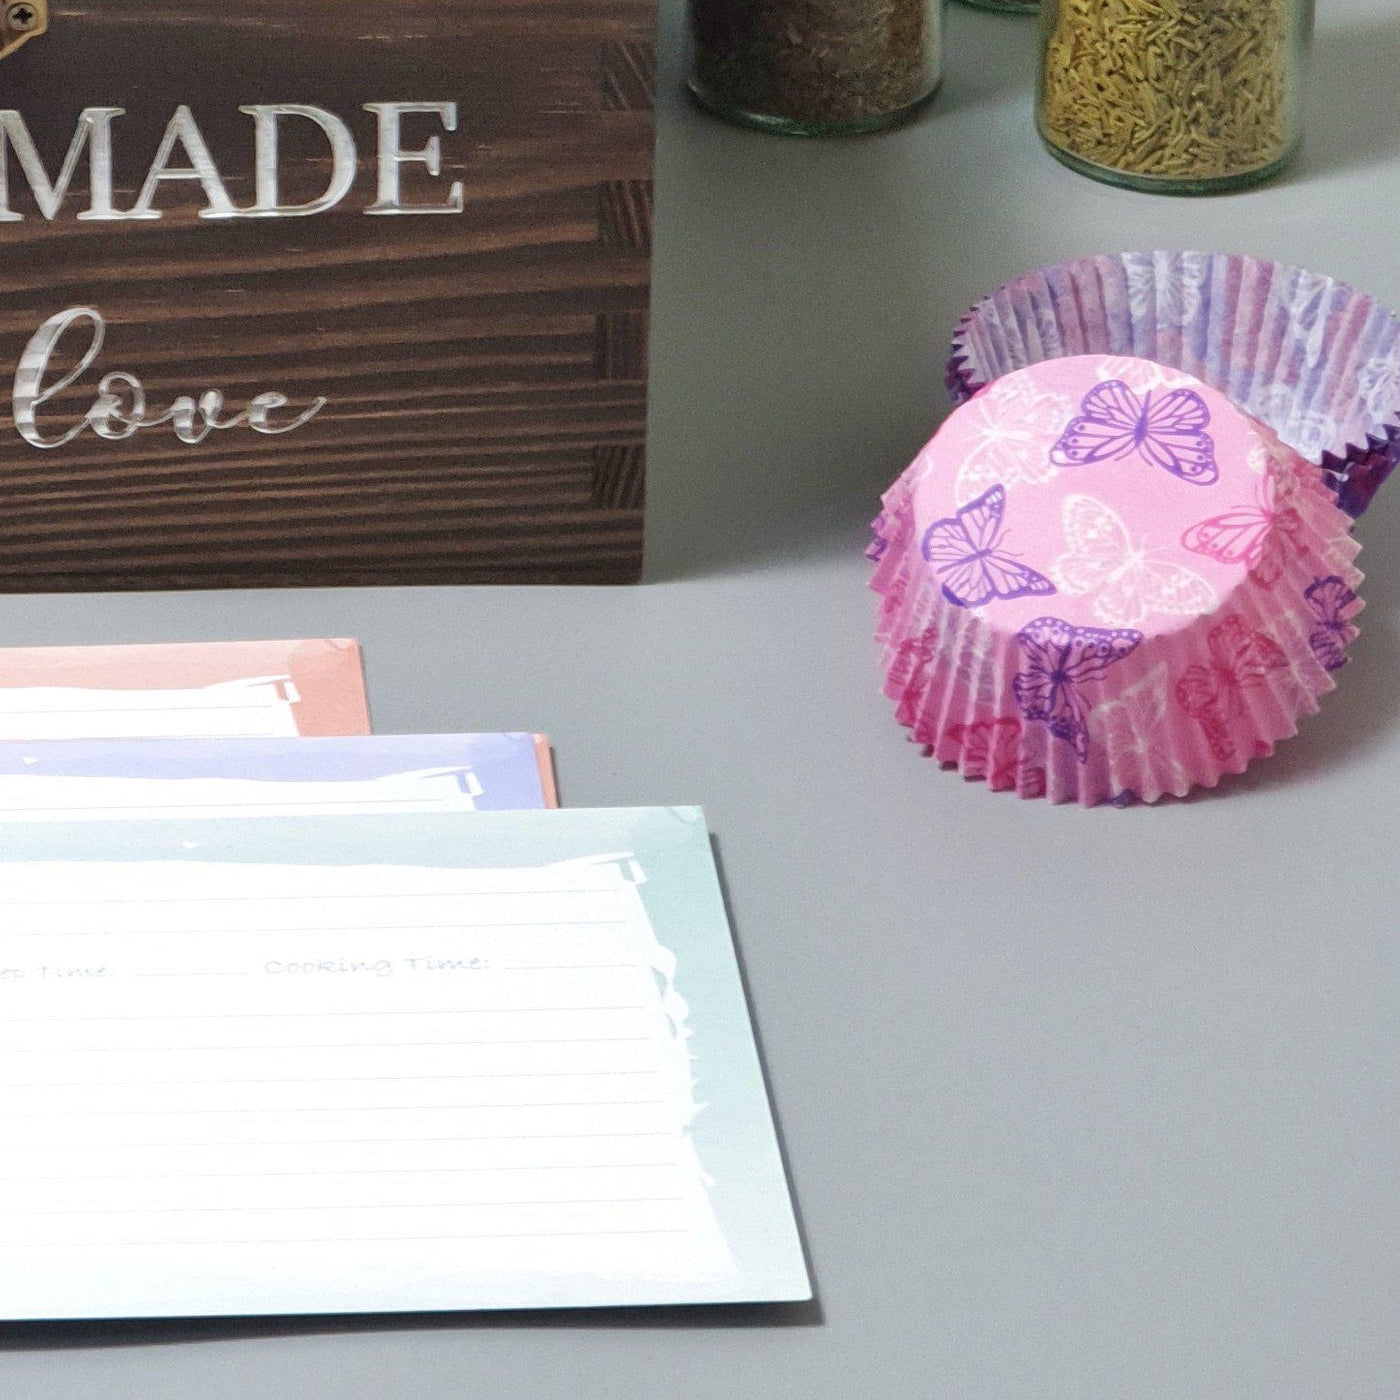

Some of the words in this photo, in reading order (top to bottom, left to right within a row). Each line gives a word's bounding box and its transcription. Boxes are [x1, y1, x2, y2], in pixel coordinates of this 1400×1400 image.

[11, 305, 328, 450] love
[262, 956, 393, 978] Cooking
[405, 954, 493, 972] Time:
